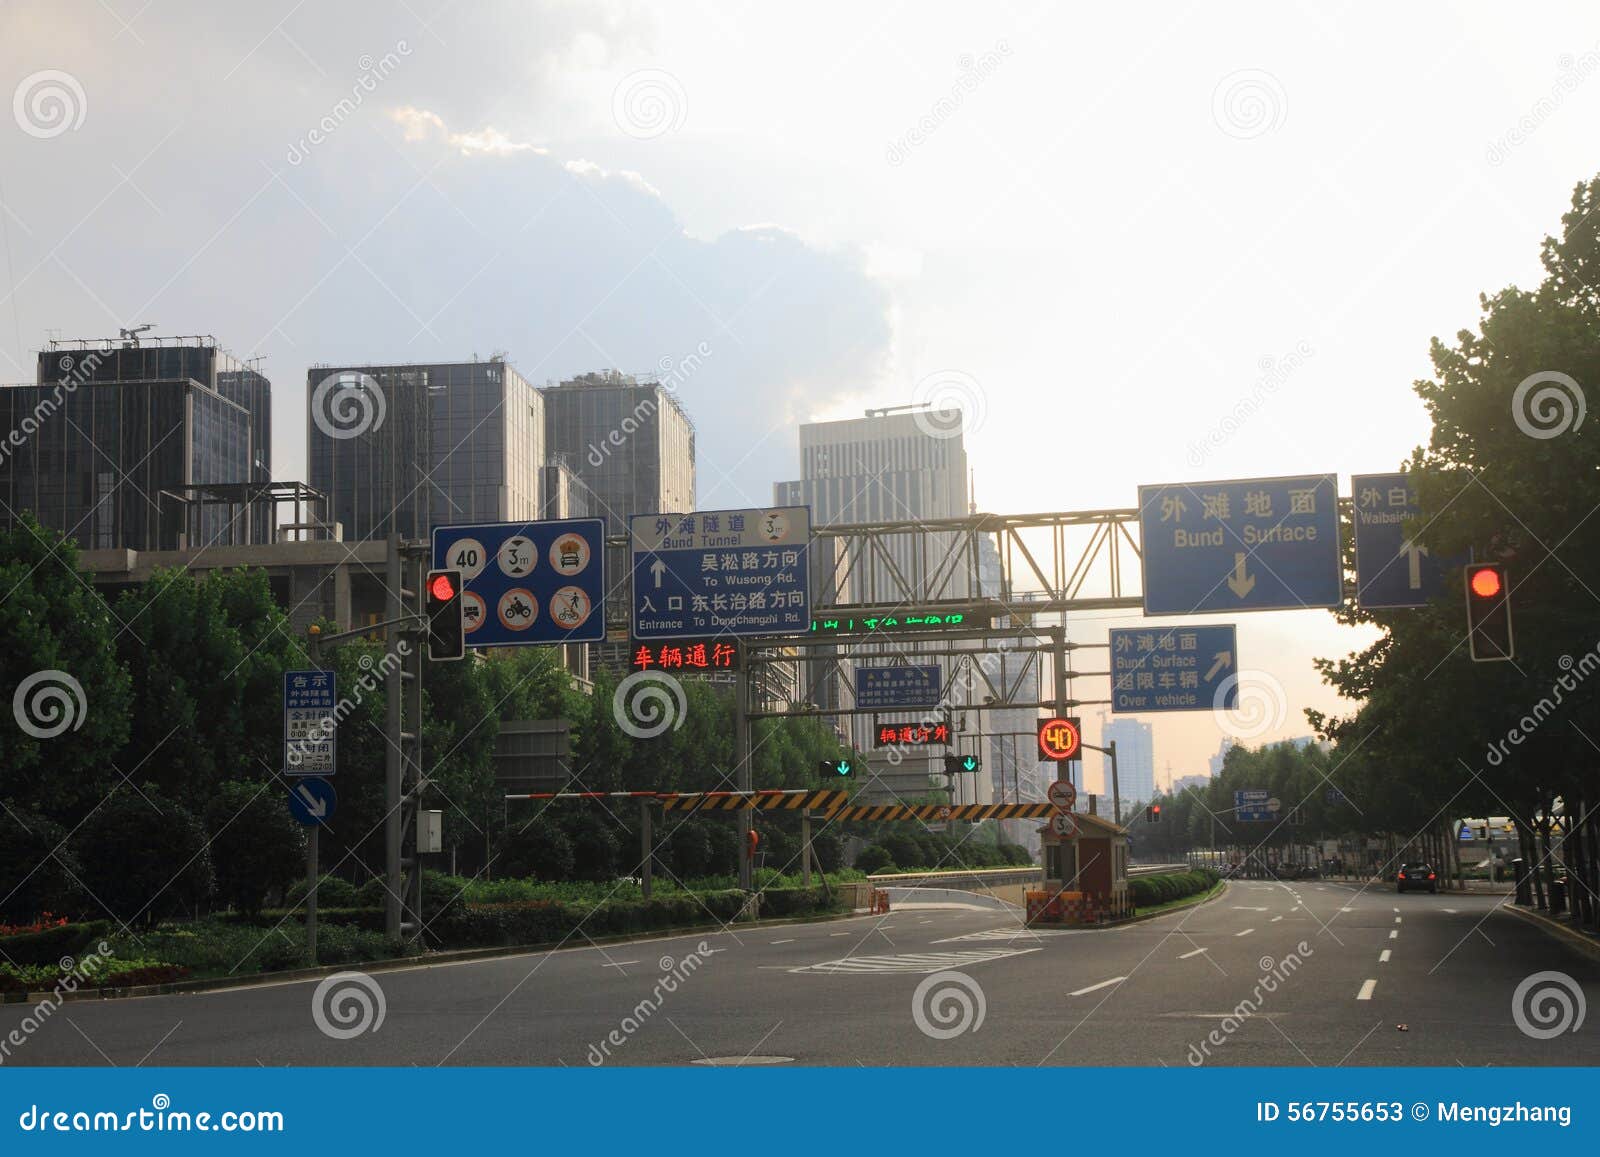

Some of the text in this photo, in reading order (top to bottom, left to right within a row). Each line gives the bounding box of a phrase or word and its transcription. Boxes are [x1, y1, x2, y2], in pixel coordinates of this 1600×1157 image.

[1160, 488, 1317, 523] 外滩地面
[1359, 486, 1419, 508] 外白
[655, 513, 746, 537] 外滩隧道
[662, 533, 742, 549] Bund Tunnel
[1174, 523, 1317, 548] Bund Surface
[455, 549, 478, 568] 40
[508, 548, 530, 566] 3m
[701, 549, 799, 572] 吴淞路方向
[703, 572, 797, 587] To Wusong Rd.
[639, 595, 684, 613] 入口
[691, 590, 804, 613] 东长治路方向
[638, 618, 683, 630] Entrance
[693, 617, 706, 627] To
[785, 612, 801, 624] Rd.
[1115, 633, 1199, 653] 外滩地面
[633, 643, 737, 671] 车辆通行
[1116, 655, 1196, 669] Bund Surface
[293, 676, 328, 688] 告示
[1116, 671, 1199, 690] 超限车辆
[1119, 693, 1197, 707] Over vehicle
[1046, 728, 1073, 750] 40
